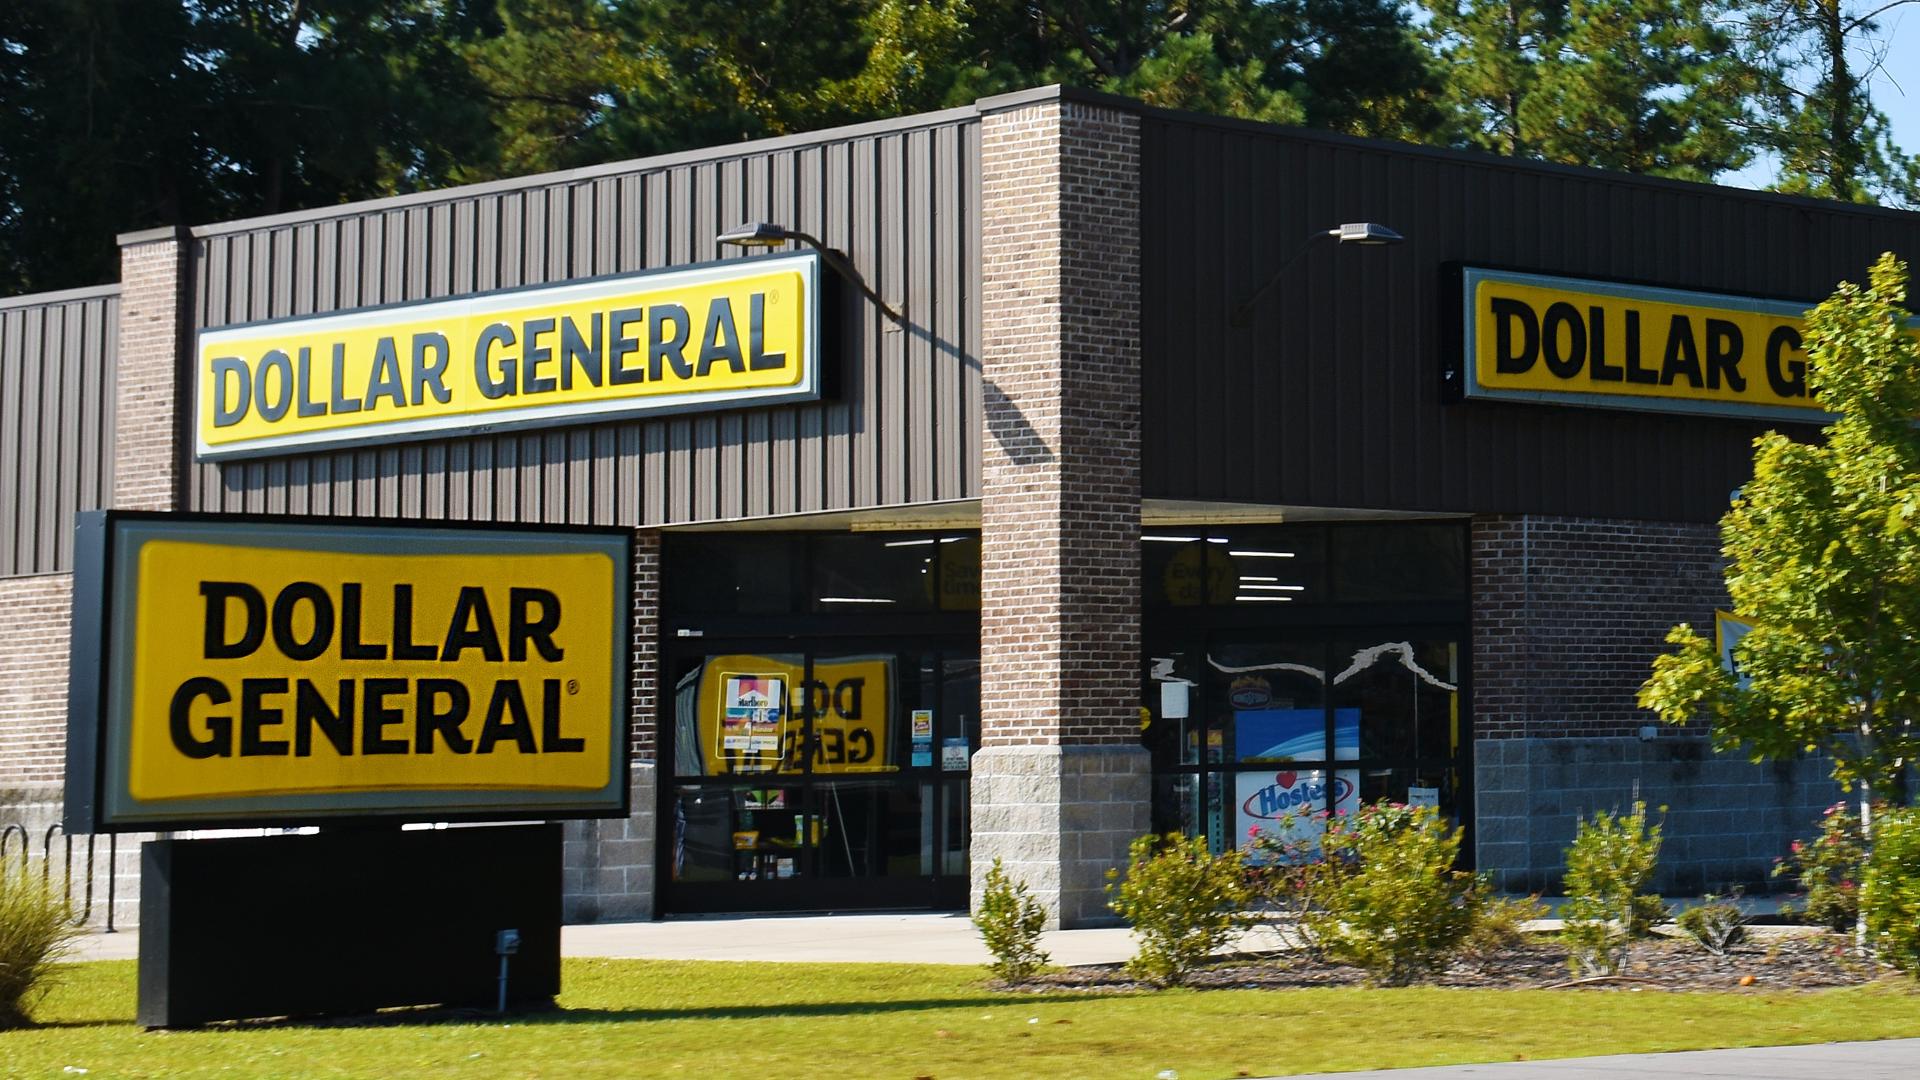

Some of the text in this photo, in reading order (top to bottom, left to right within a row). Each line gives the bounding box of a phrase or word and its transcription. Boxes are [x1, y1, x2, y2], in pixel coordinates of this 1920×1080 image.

[212, 333, 453, 429] DOLLAR
[1490, 296, 1748, 394] DOLLAR
[199, 580, 565, 663] DOLLAR
